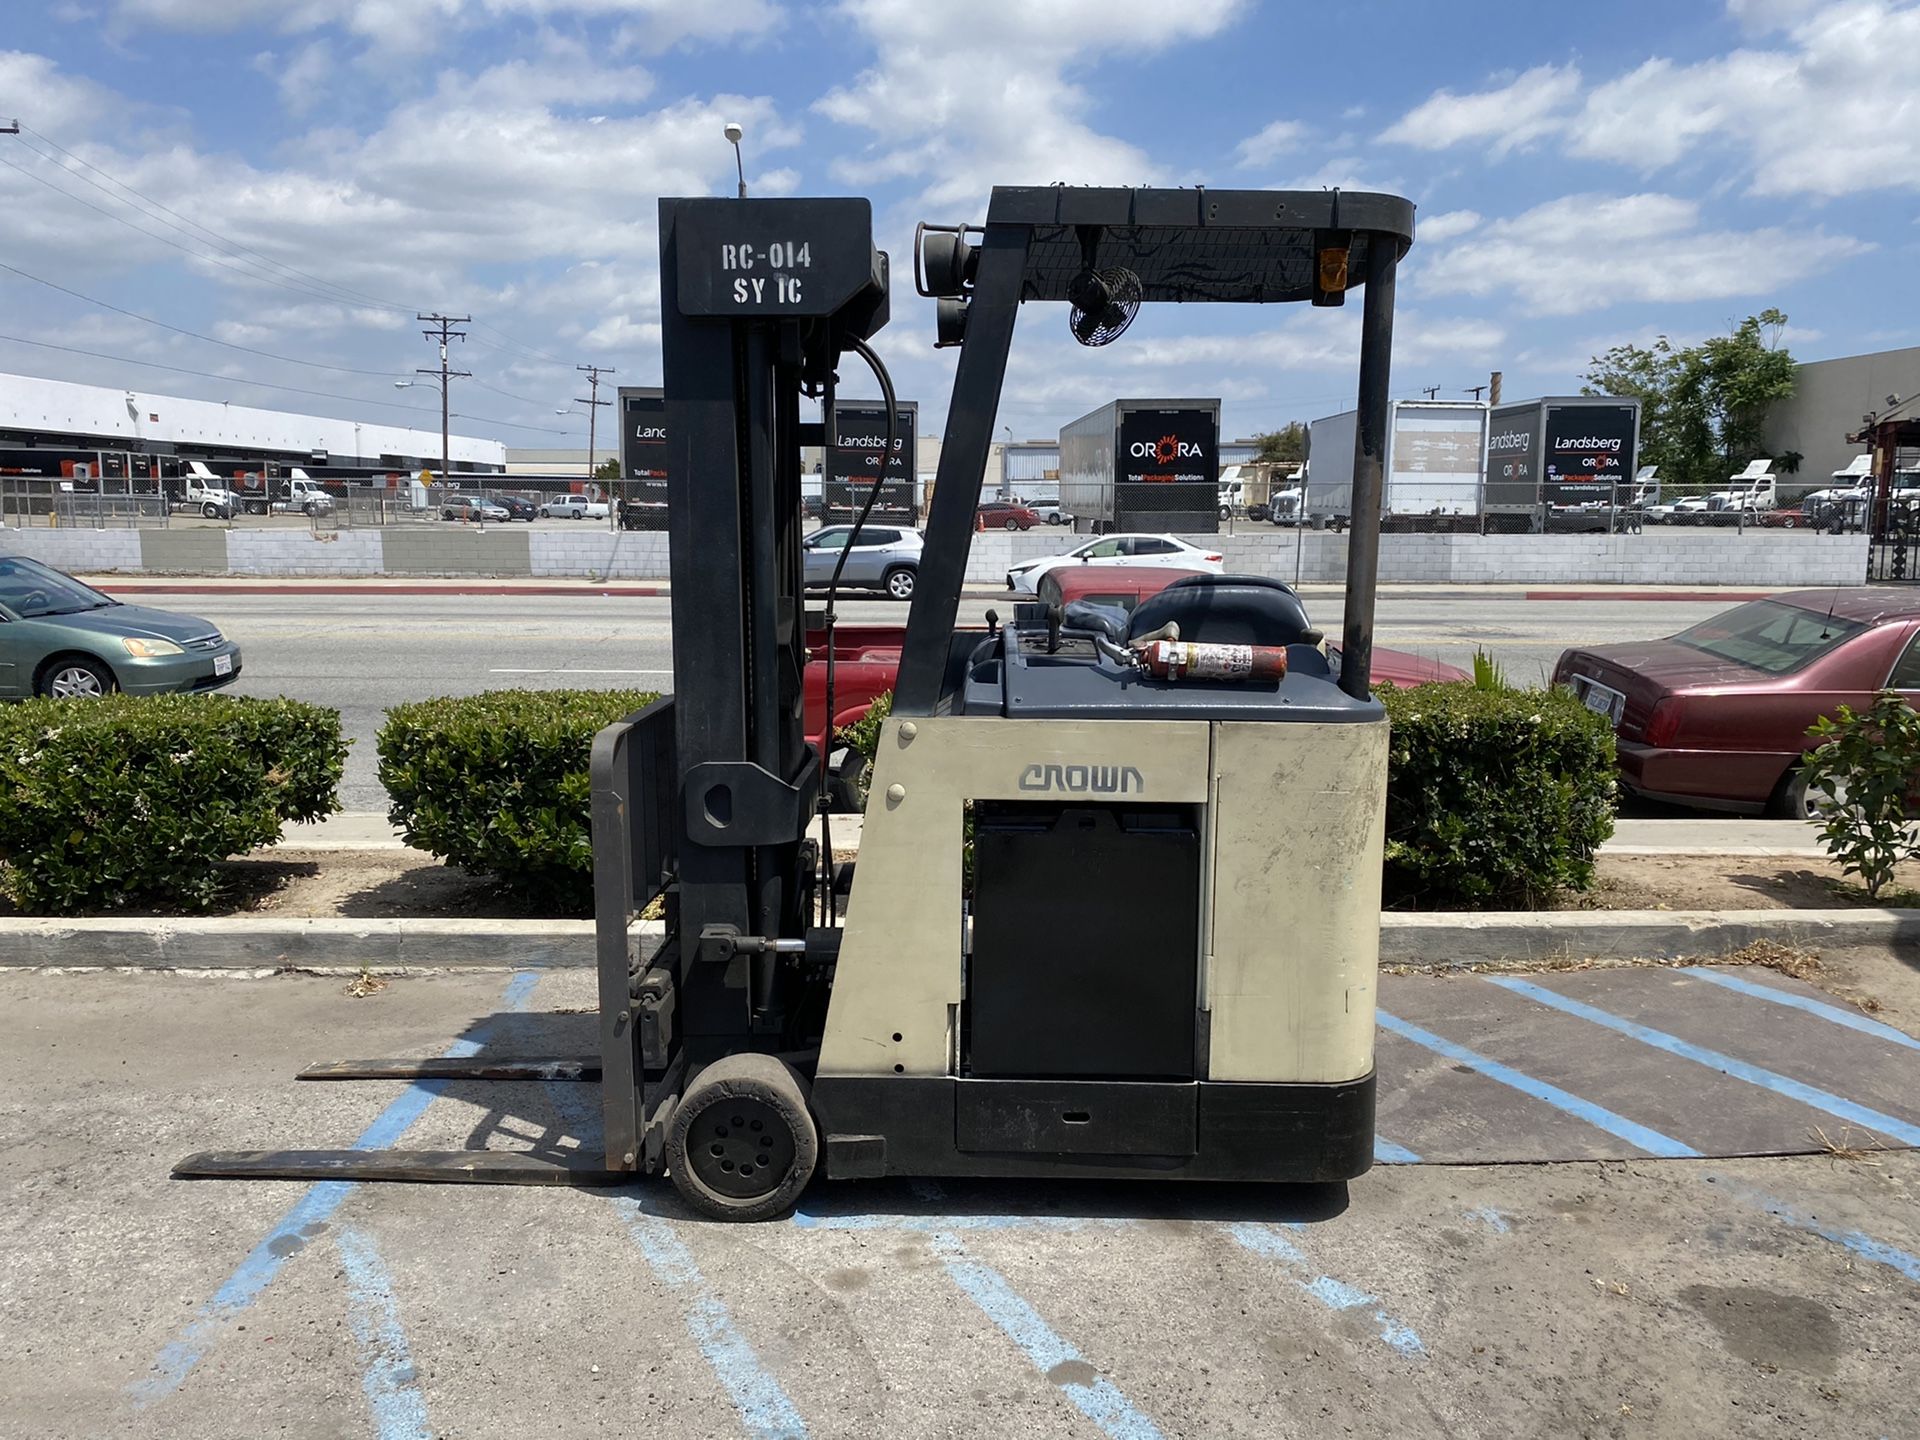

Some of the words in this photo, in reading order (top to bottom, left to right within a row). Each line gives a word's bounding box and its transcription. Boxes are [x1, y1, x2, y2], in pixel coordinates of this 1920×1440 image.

[733, 278, 765, 303] SY
[837, 435, 903, 451] Landsbeg
[1129, 435, 1203, 463] ORORA
[1554, 436, 1621, 451] Landsberg
[1018, 764, 1144, 793] CROWN
